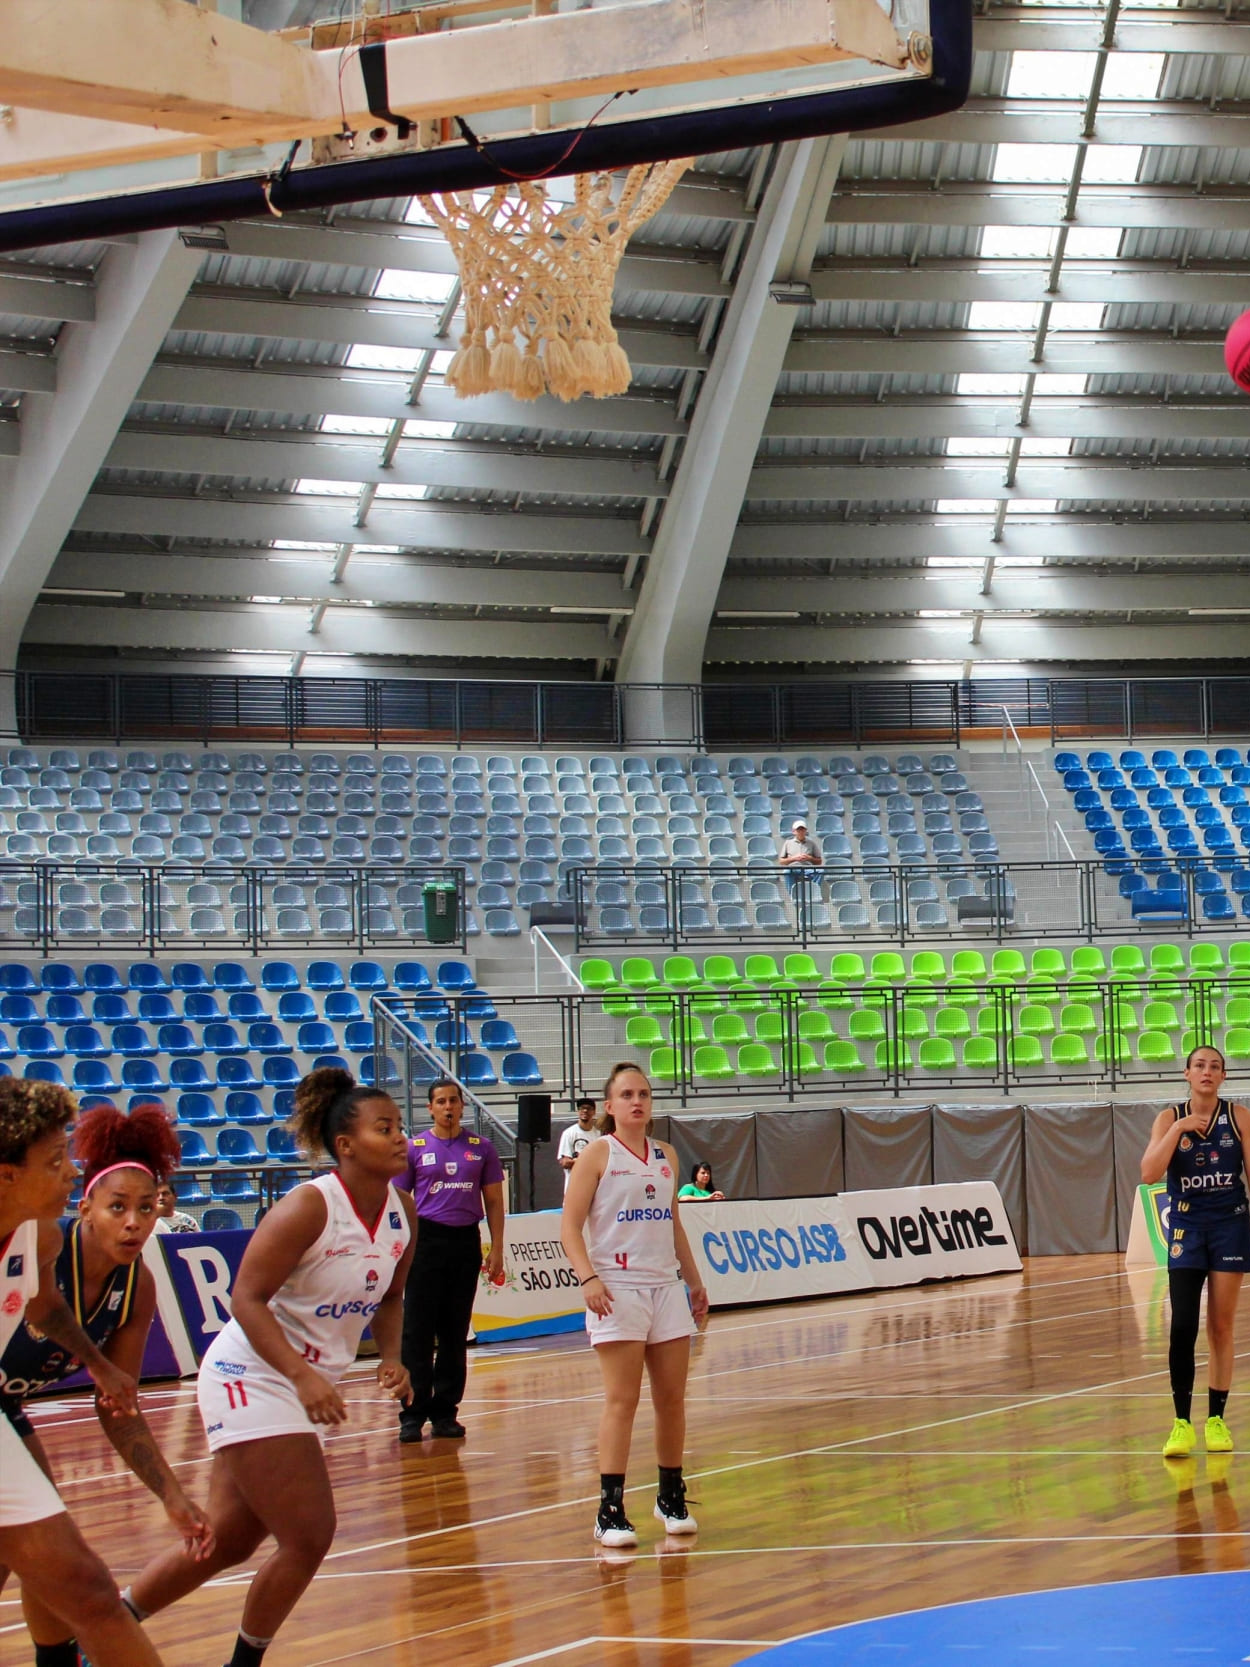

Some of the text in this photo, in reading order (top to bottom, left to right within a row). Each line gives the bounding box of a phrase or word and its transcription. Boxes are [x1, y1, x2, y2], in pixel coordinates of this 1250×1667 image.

[1180, 1171, 1233, 1192] pontz
[617, 1208, 672, 1222] CURSOA
[616, 1252, 627, 1270] 4
[521, 1266, 582, 1291] SÃO JOS
[223, 1381, 248, 1409] 11
